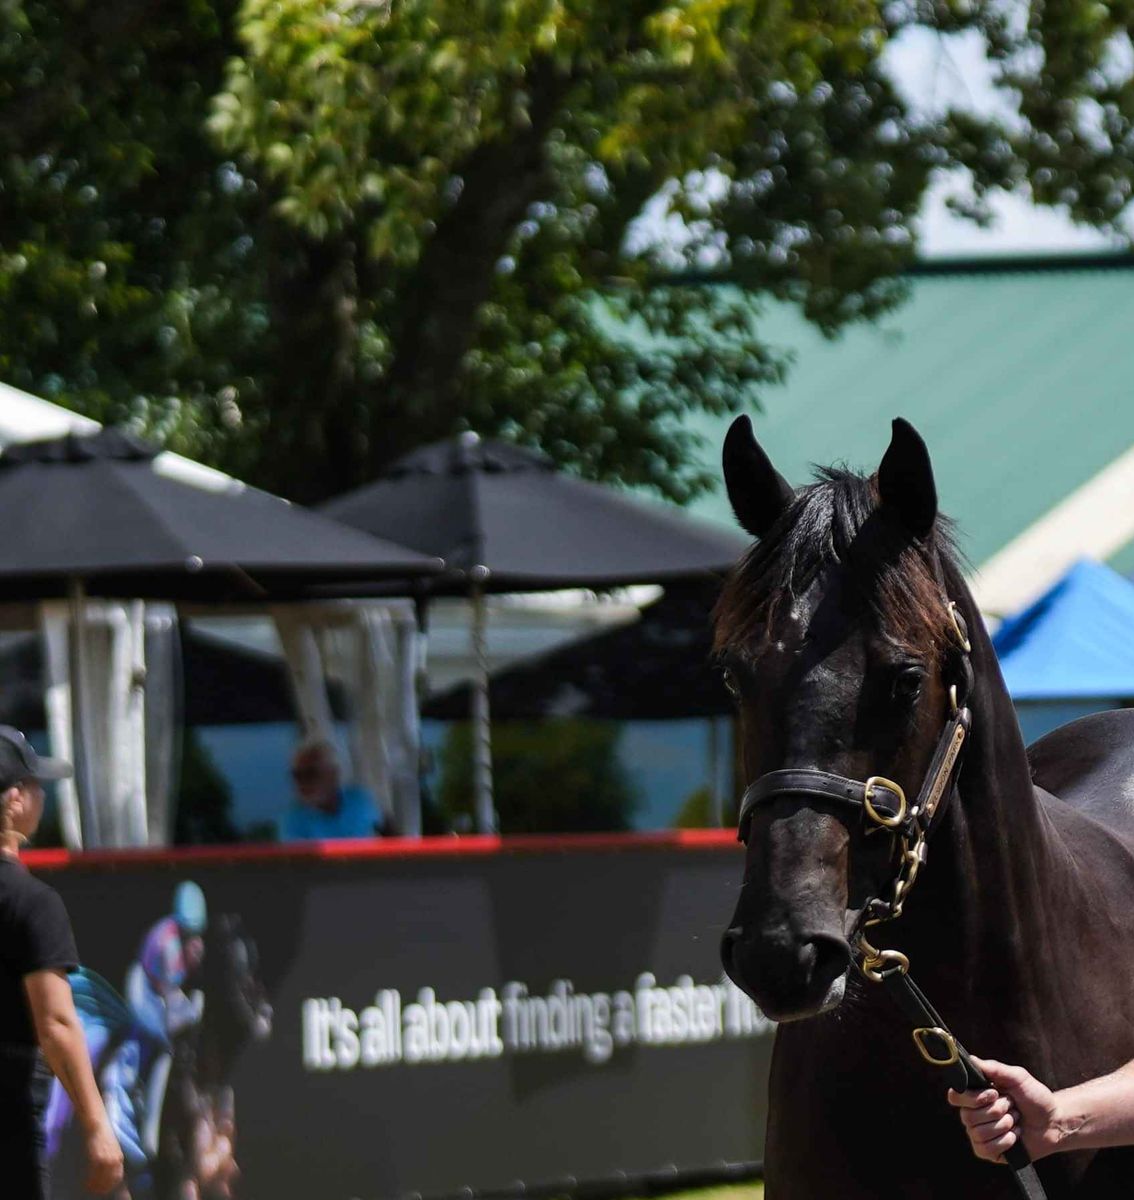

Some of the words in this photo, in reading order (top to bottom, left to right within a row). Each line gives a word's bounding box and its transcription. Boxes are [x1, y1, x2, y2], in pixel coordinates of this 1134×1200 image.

[302, 996, 360, 1070] It's
[359, 987, 402, 1066] all
[402, 985, 503, 1064] about
[501, 979, 613, 1064] finding
[612, 989, 636, 1044] a
[635, 970, 725, 1044] faster
